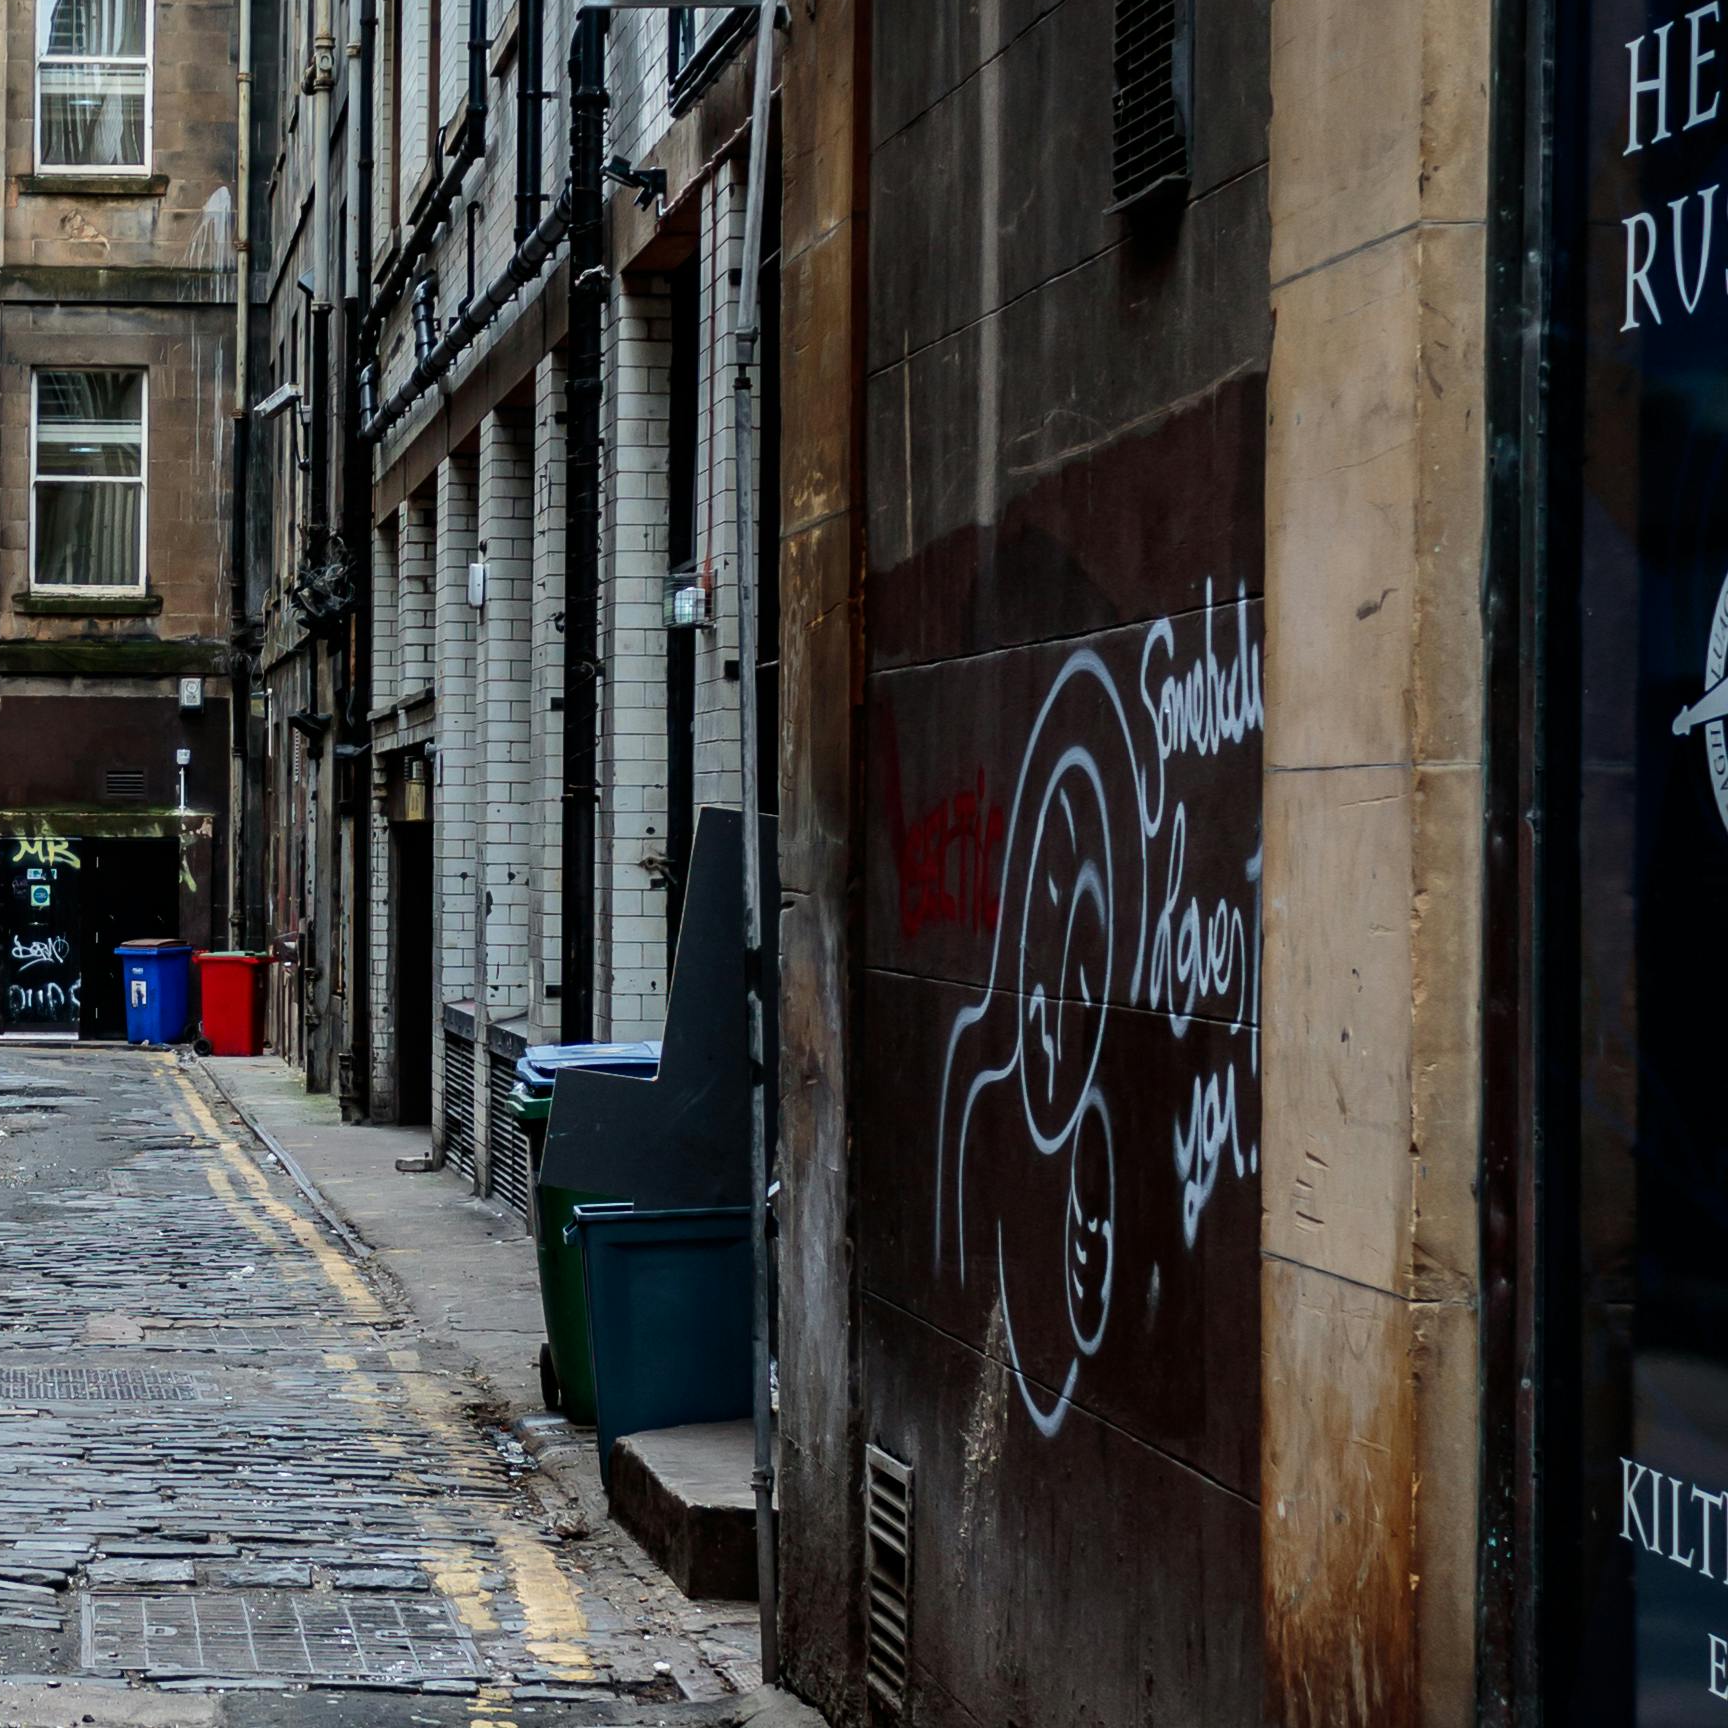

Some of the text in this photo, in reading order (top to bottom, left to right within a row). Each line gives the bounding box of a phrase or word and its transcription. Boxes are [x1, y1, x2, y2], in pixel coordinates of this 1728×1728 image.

[1622, 0, 1721, 157] HE
[1619, 183, 1728, 334] RU
[1618, 1456, 1728, 1586] KILT
